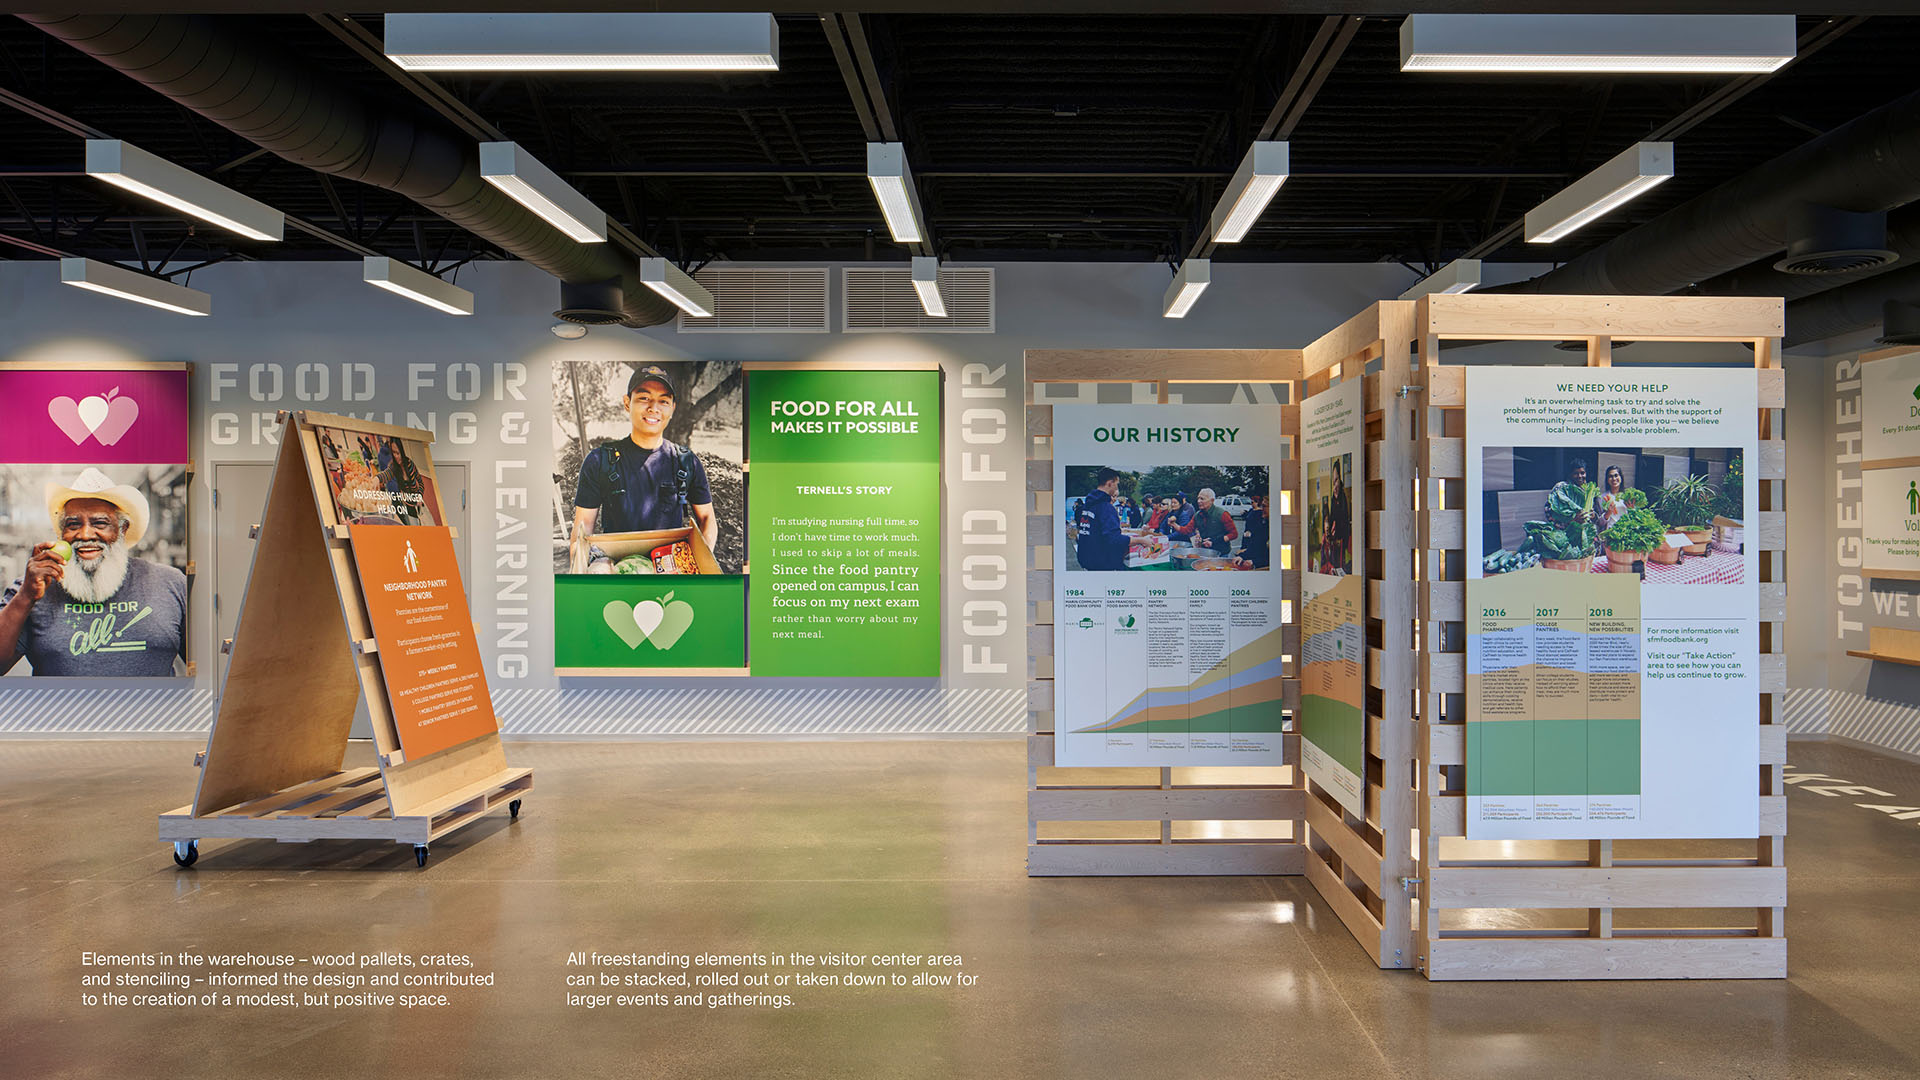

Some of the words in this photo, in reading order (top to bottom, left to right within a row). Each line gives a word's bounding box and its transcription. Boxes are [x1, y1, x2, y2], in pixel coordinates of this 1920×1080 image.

[210, 362, 376, 401] FOOD
[408, 362, 528, 401] FOR
[1557, 384, 1573, 392] WE
[1577, 384, 1604, 392] NEED
[1608, 384, 1638, 392] YOUR
[1642, 384, 1668, 392] HELP
[1549, 398, 1604, 406] overwhelming
[772, 401, 830, 416] FOOD
[836, 401, 876, 416] FOR
[880, 401, 918, 416] ALL
[1504, 407, 1536, 417] problem
[1548, 408, 1576, 416] hunger
[772, 422, 823, 433] MAKES
[828, 422, 842, 433] IT
[846, 422, 918, 433] POSSIBLE
[962, 362, 1007, 482] FOR
[1094, 428, 1139, 442] OUR
[1148, 428, 1239, 442] HISTORY
[1566, 426, 1594, 435] hunger
[1882, 427, 1897, 435] Every
[796, 486, 852, 494] TERNELL'S
[856, 486, 892, 494] STORY
[353, 489, 397, 502] ADDRESSING
[397, 491, 425, 503] HUNGER
[1835, 359, 1863, 639] TOGETHER
[377, 504, 397, 515] HEAD
[397, 505, 408, 515] ON
[788, 518, 827, 527] studying
[830, 518, 864, 527] nursing
[866, 517, 882, 526] full
[884, 518, 907, 526] time,
[1866, 537, 1881, 545] Thank
[1892, 537, 1900, 545] for
[1900, 538, 1920, 546] making
[1887, 548, 1904, 556] Please
[1905, 548, 1920, 557] bring
[495, 460, 529, 679] LEARNING
[773, 564, 807, 574] Since
[813, 564, 834, 574] the
[840, 564, 868, 574] food
[874, 566, 918, 577] pantry
[384, 581, 427, 592] NEIGHBORHOOD
[428, 579, 448, 588] PANTRY
[772, 580, 816, 593] opened
[838, 583, 888, 593] campus,
[890, 581, 895, 590] I
[898, 583, 919, 591] can
[406, 592, 433, 601] NETWORK
[962, 509, 1008, 674] FOOD
[64, 603, 104, 614] FOOD
[109, 601, 138, 613] FOR
[773, 596, 806, 607] focus
[830, 599, 850, 609] my
[854, 598, 881, 607] next
[886, 599, 919, 607] exam
[1872, 590, 1909, 617] WE
[1483, 608, 1506, 616] 2016
[1536, 608, 1558, 616] 2017
[1590, 608, 1612, 616] 2018
[798, 630, 824, 638] meal.
[1648, 636, 1708, 644] sfmfoodbank.org
